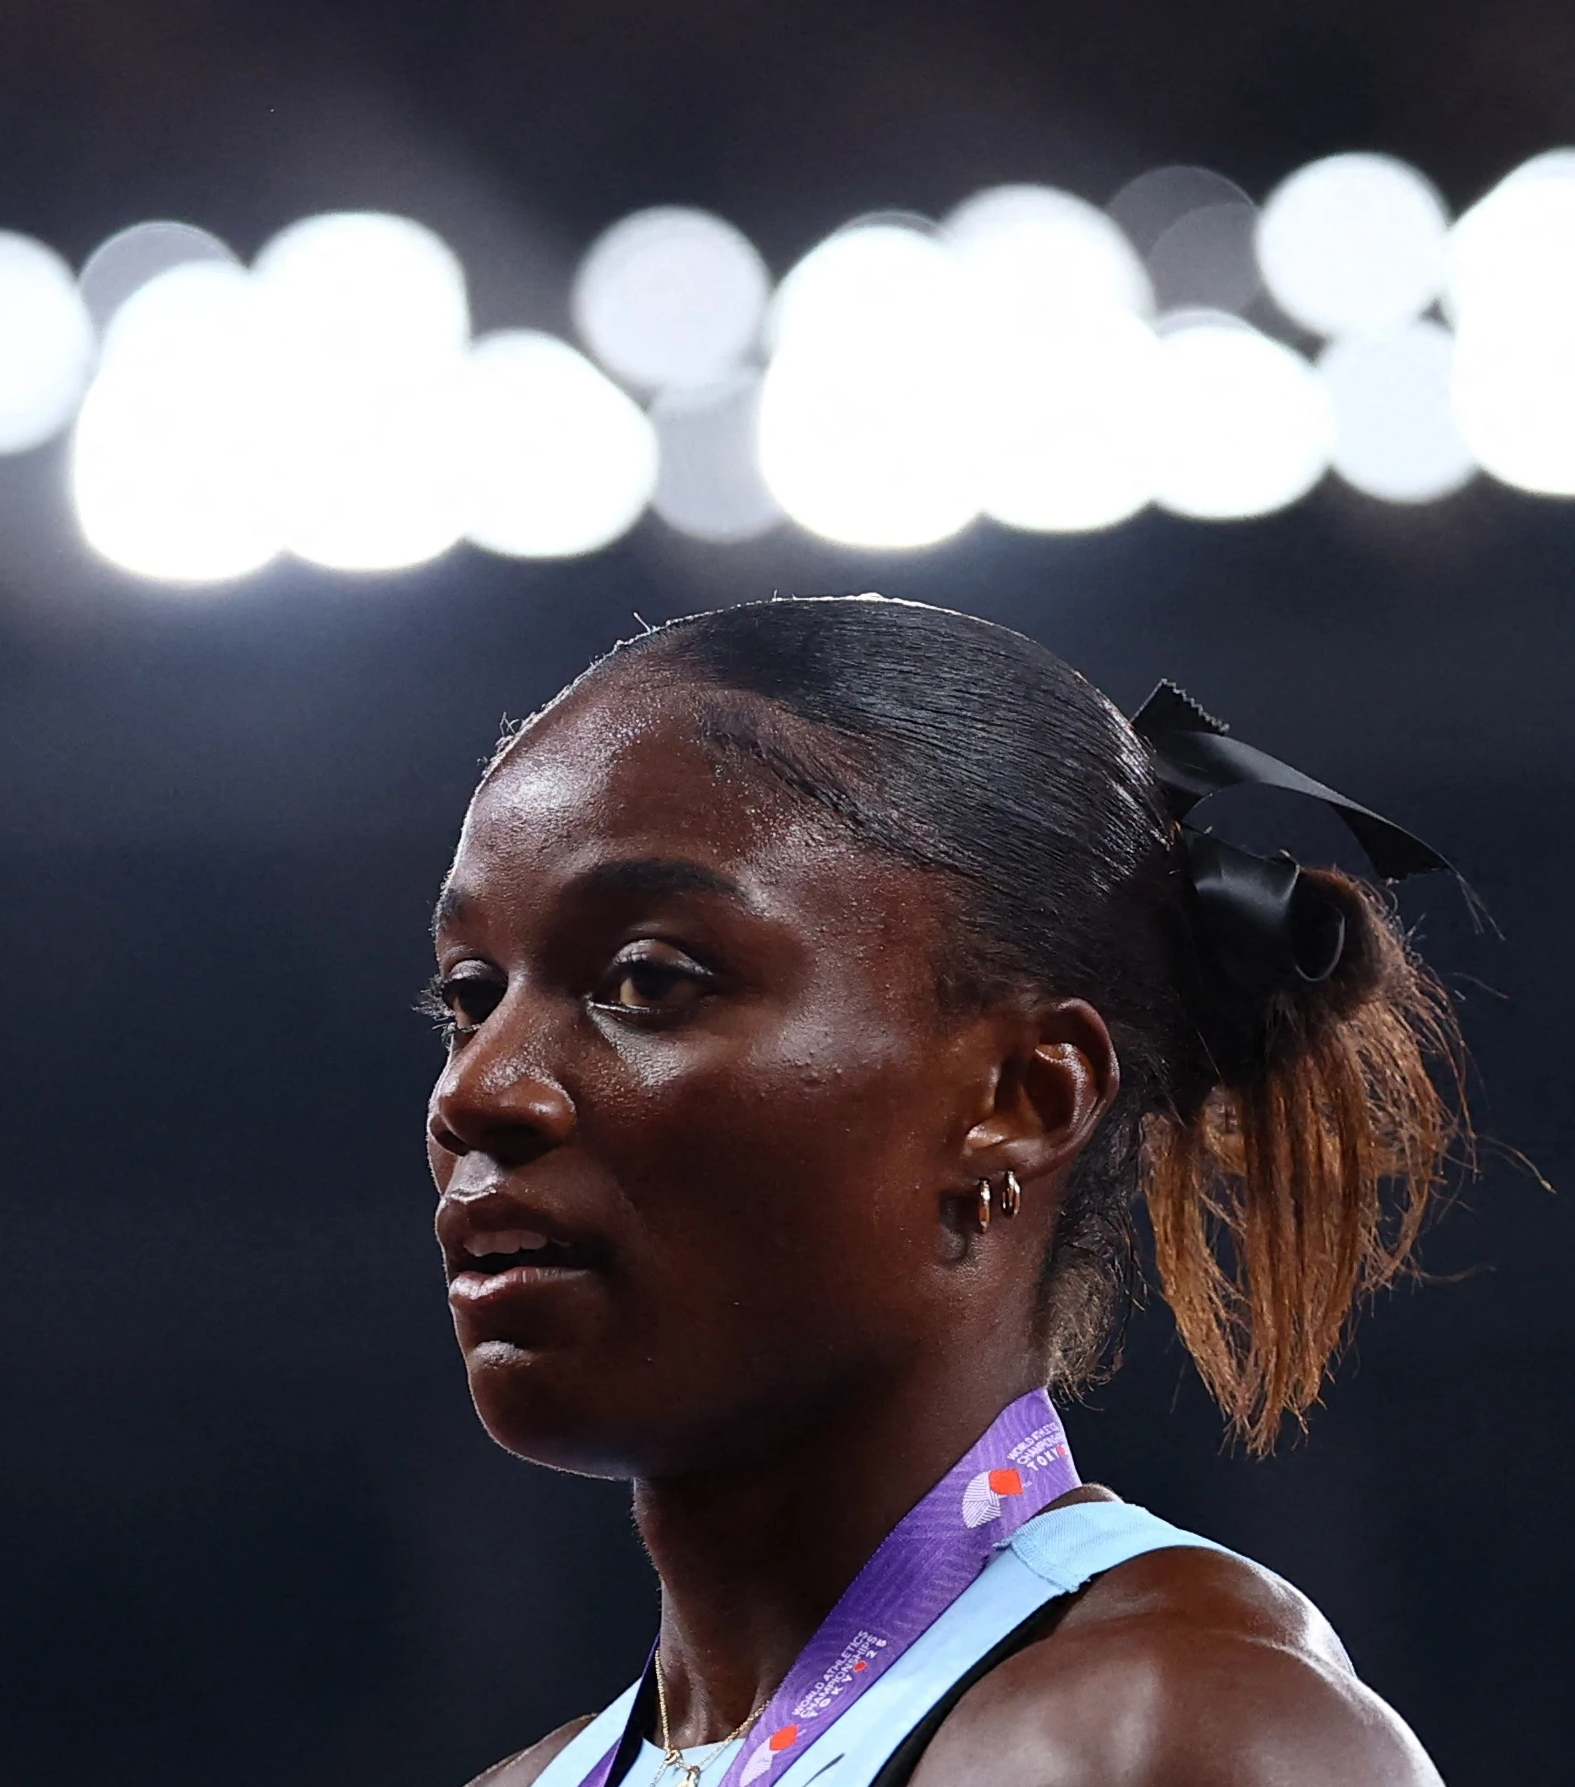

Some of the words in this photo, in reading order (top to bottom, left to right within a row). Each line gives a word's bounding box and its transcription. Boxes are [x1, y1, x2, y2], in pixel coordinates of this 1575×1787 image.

[792, 1682, 825, 1715] WORLD
[823, 1630, 869, 1681] ATHLETICS
[799, 1634, 878, 1718] CHAMPIONSHIPS
